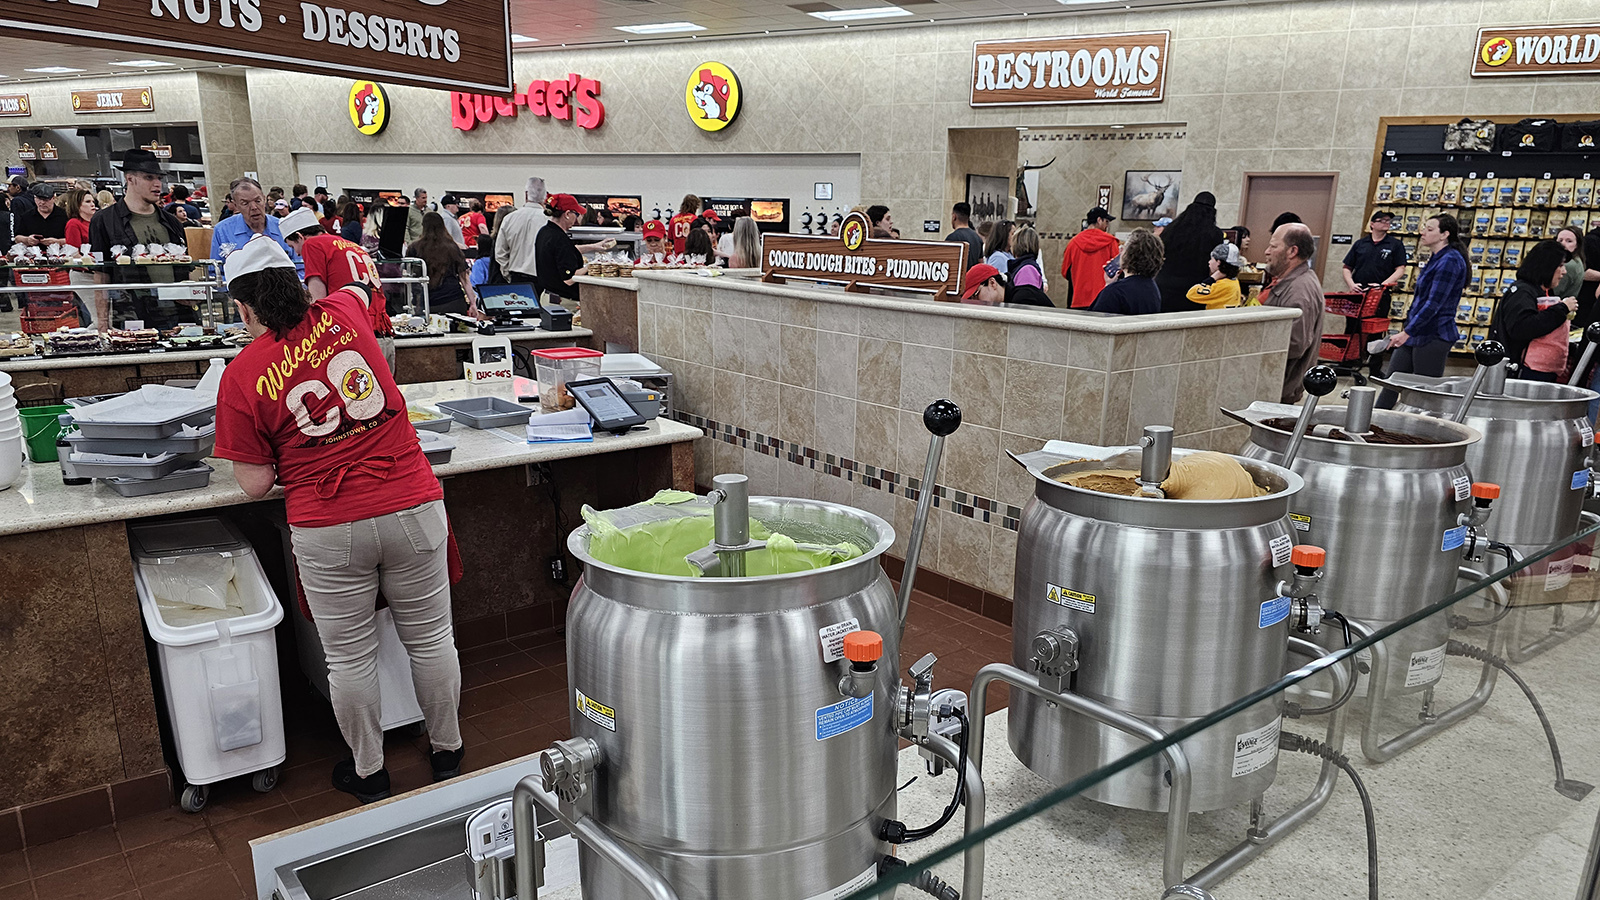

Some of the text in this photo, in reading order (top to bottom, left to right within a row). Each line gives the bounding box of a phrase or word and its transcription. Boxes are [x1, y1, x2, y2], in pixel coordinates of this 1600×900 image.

[302, 4, 461, 63] DESSERTS
[1515, 34, 1600, 65] WORLD
[975, 45, 1160, 91] RESTROOMS
[97, 92, 123, 107] JERKY
[1095, 88, 1119, 98] World
[332, 219, 341, 234] 4
[769, 250, 949, 282] COOKIE DOUGH BITES PUDDINGS
[329, 324, 341, 335] TO
[256, 312, 333, 401] Welcome
[286, 349, 387, 437] CO
[368, 421, 378, 429] CO
